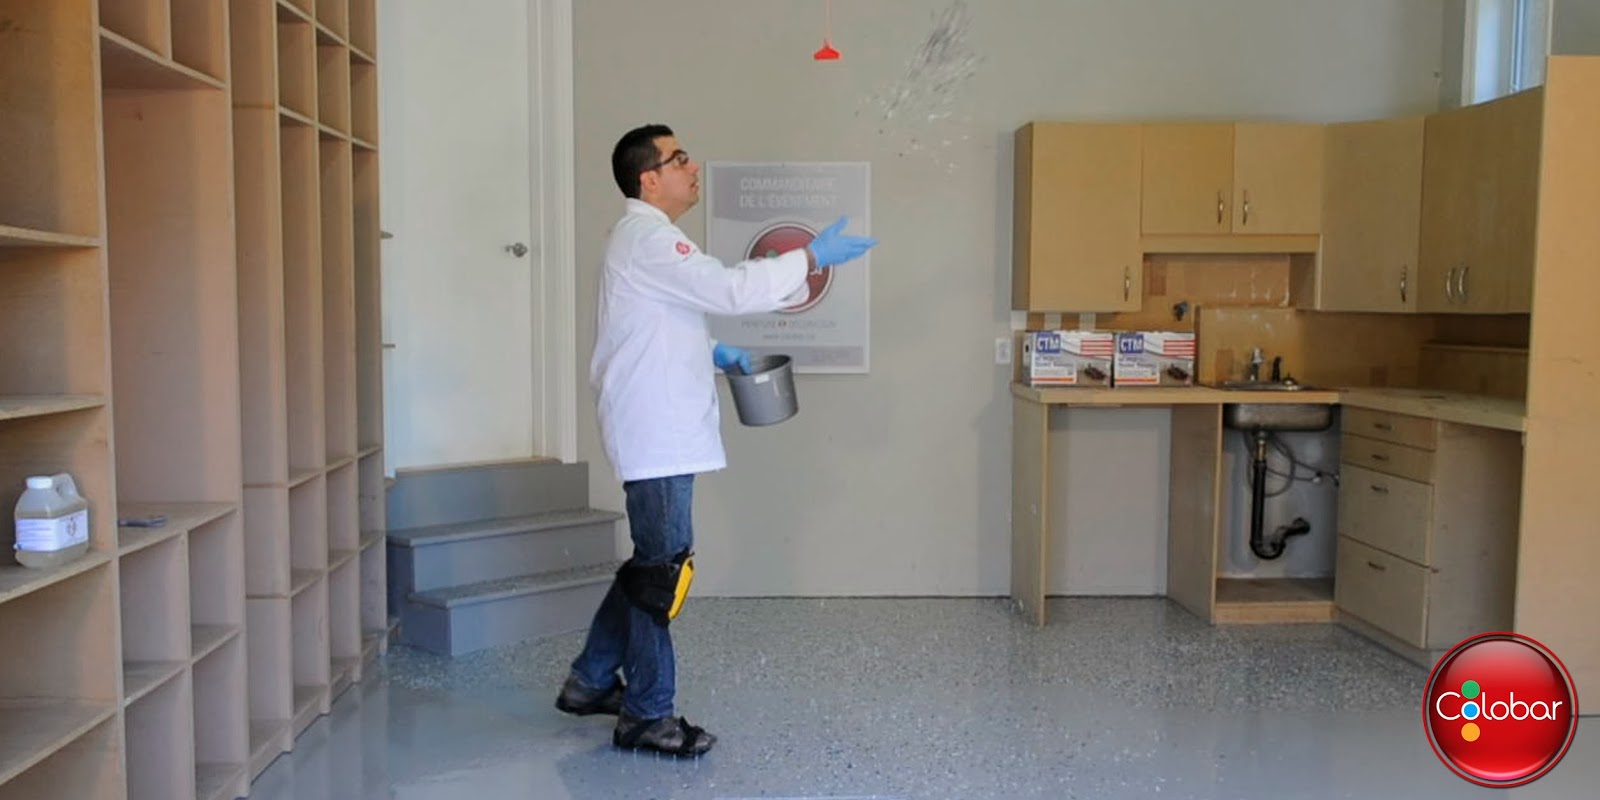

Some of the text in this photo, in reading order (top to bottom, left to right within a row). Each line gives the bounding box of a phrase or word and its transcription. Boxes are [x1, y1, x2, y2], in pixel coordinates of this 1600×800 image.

[740, 195, 755, 208] DE
[1037, 337, 1060, 351] CTM
[1120, 338, 1143, 351] CTM
